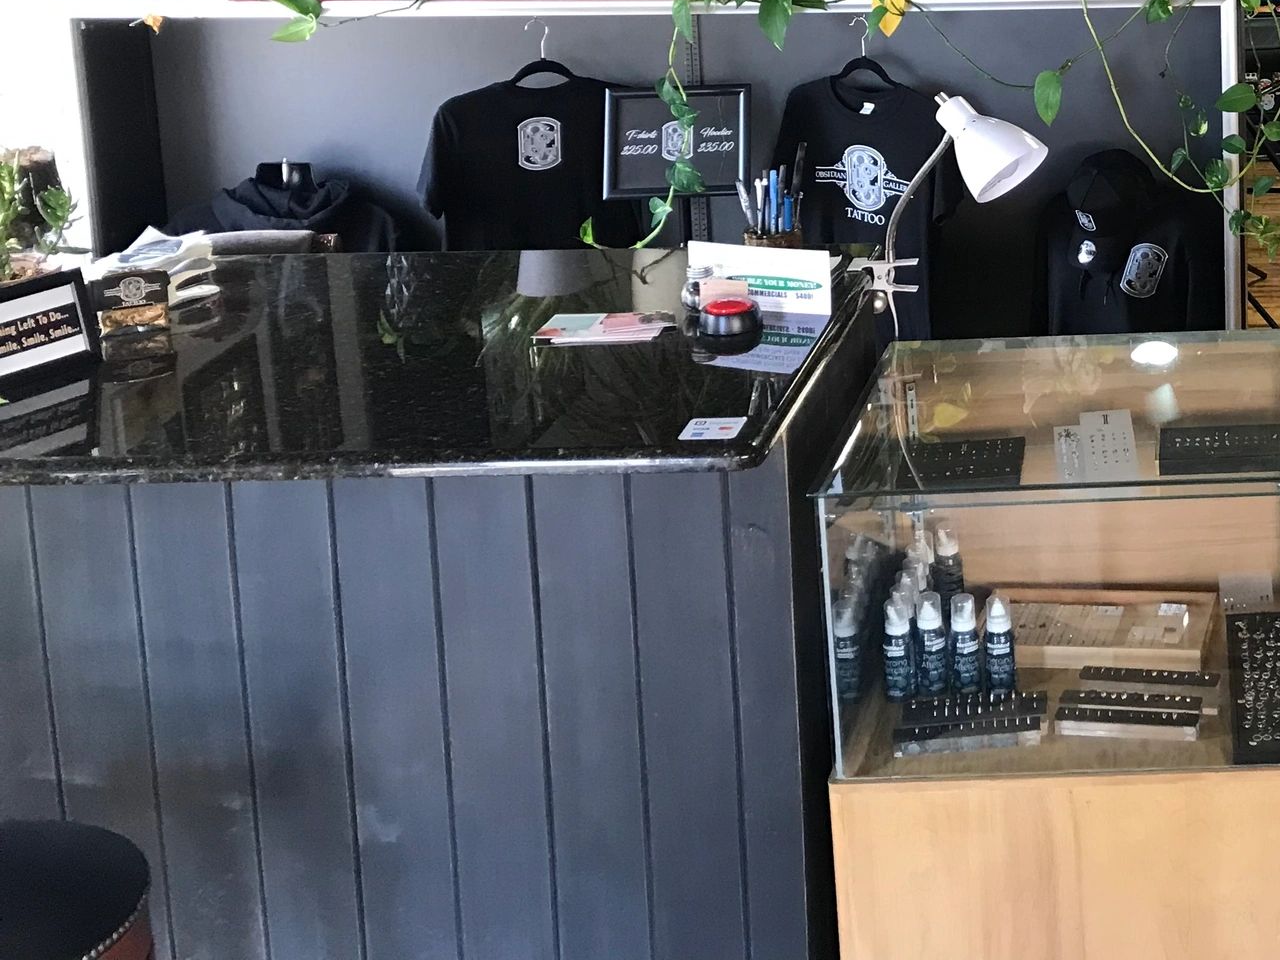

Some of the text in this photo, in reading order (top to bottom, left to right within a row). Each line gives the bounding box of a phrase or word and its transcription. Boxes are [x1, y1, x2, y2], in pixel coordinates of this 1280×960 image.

[625, 129, 658, 140] T-shirts
[700, 126, 733, 138] Hoodies
[620, 144, 658, 155] $25.00
[697, 141, 735, 152] $35.00
[815, 170, 847, 179] OBSIDIAN
[845, 207, 885, 225] TATTOO
[17, 318, 36, 332] Left
[36, 314, 48, 326] To
[21, 332, 49, 348] Smile,
